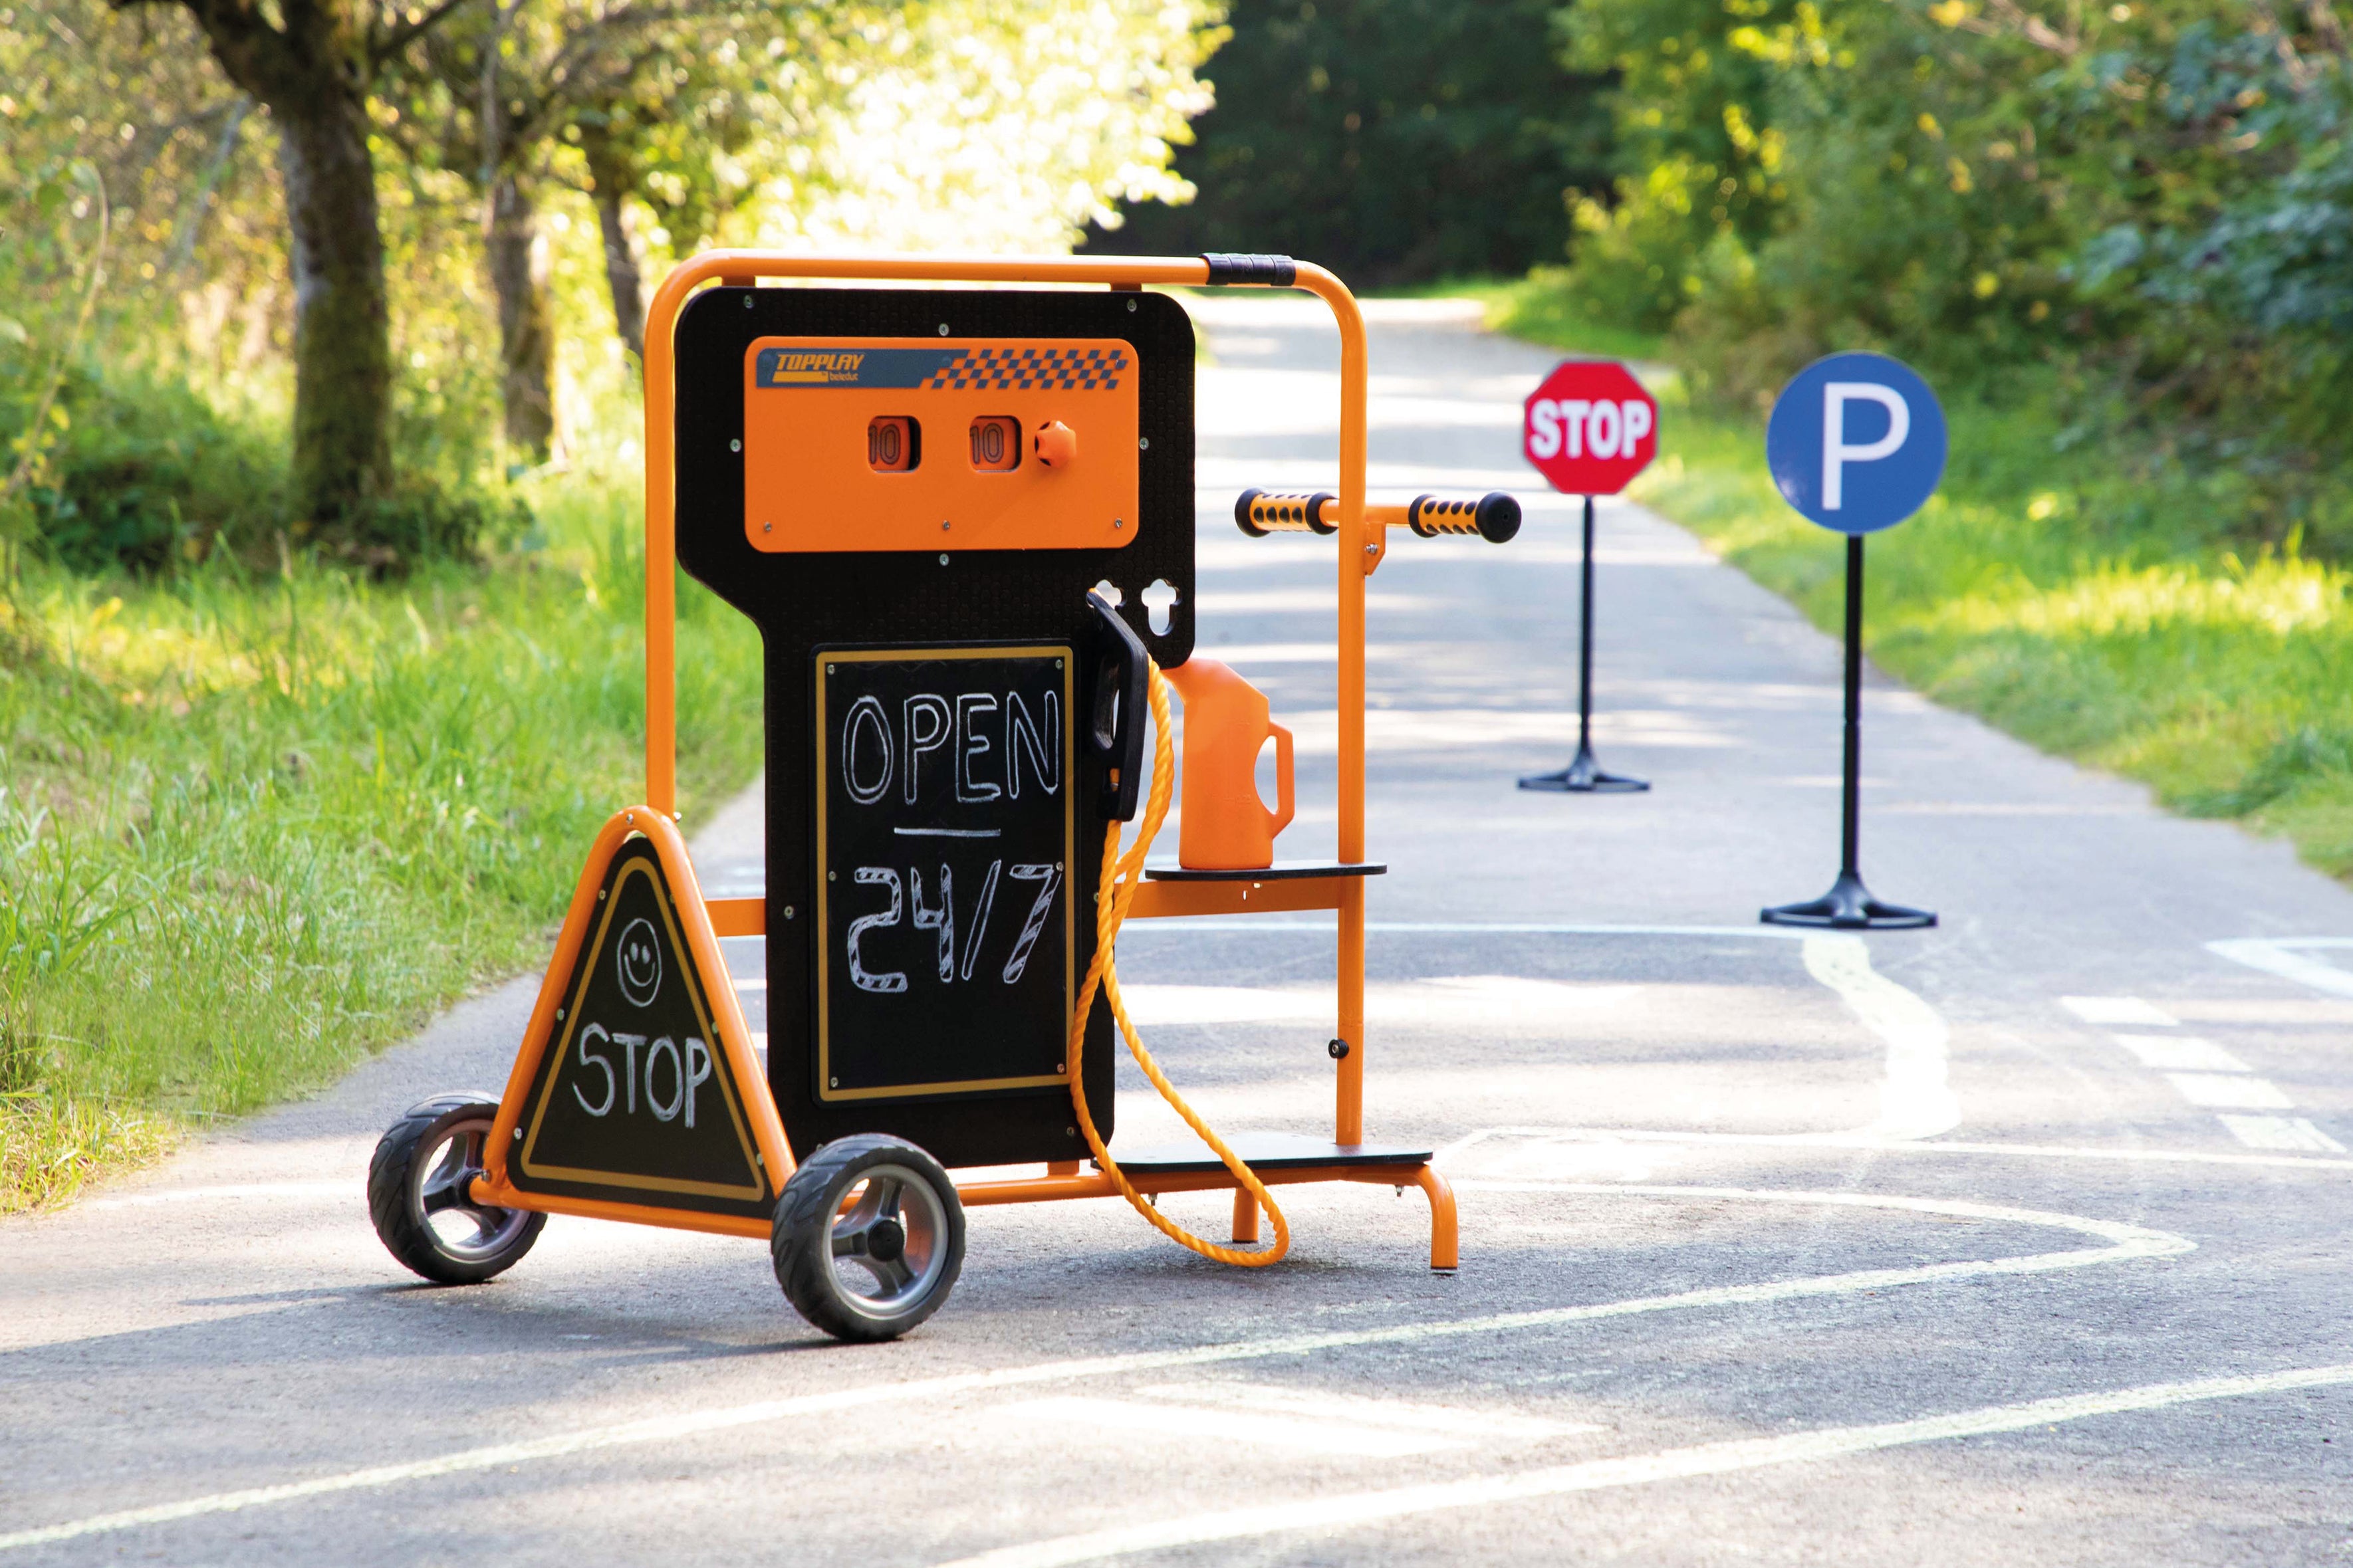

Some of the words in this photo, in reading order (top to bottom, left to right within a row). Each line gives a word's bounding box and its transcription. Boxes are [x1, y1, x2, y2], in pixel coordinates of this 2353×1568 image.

[777, 354, 864, 370] TOPPLAY
[868, 423, 900, 465] 10
[969, 423, 1004, 464] 10
[1530, 399, 1652, 459] STOP
[1822, 382, 1910, 510] P
[842, 691, 1059, 805] OPEN
[847, 860, 1062, 992] 24/7
[572, 1022, 711, 1128] STOP
